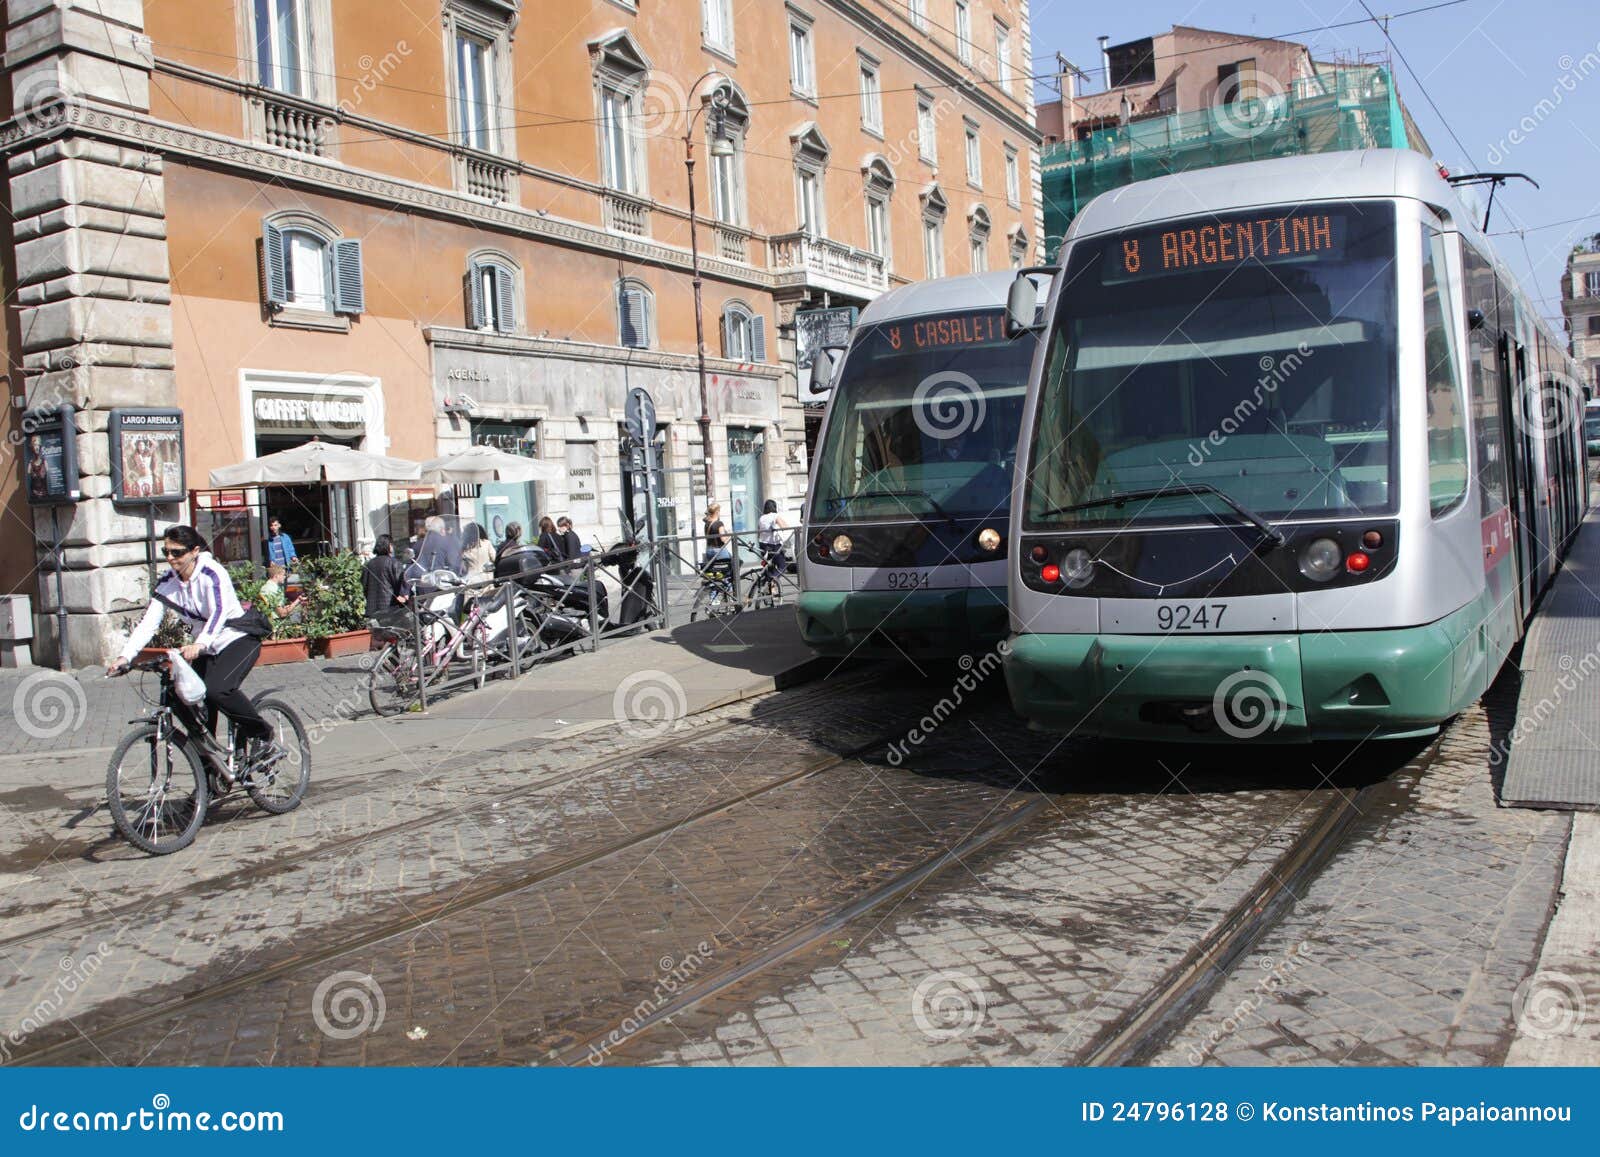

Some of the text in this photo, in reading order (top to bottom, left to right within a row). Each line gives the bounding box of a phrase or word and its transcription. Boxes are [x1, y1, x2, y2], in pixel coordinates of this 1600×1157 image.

[1123, 239, 1141, 272] 8
[890, 327, 902, 349] 8
[122, 415, 177, 425] LARGO ARENULA
[888, 572, 928, 589] 9234
[1157, 604, 1228, 630] 9247
